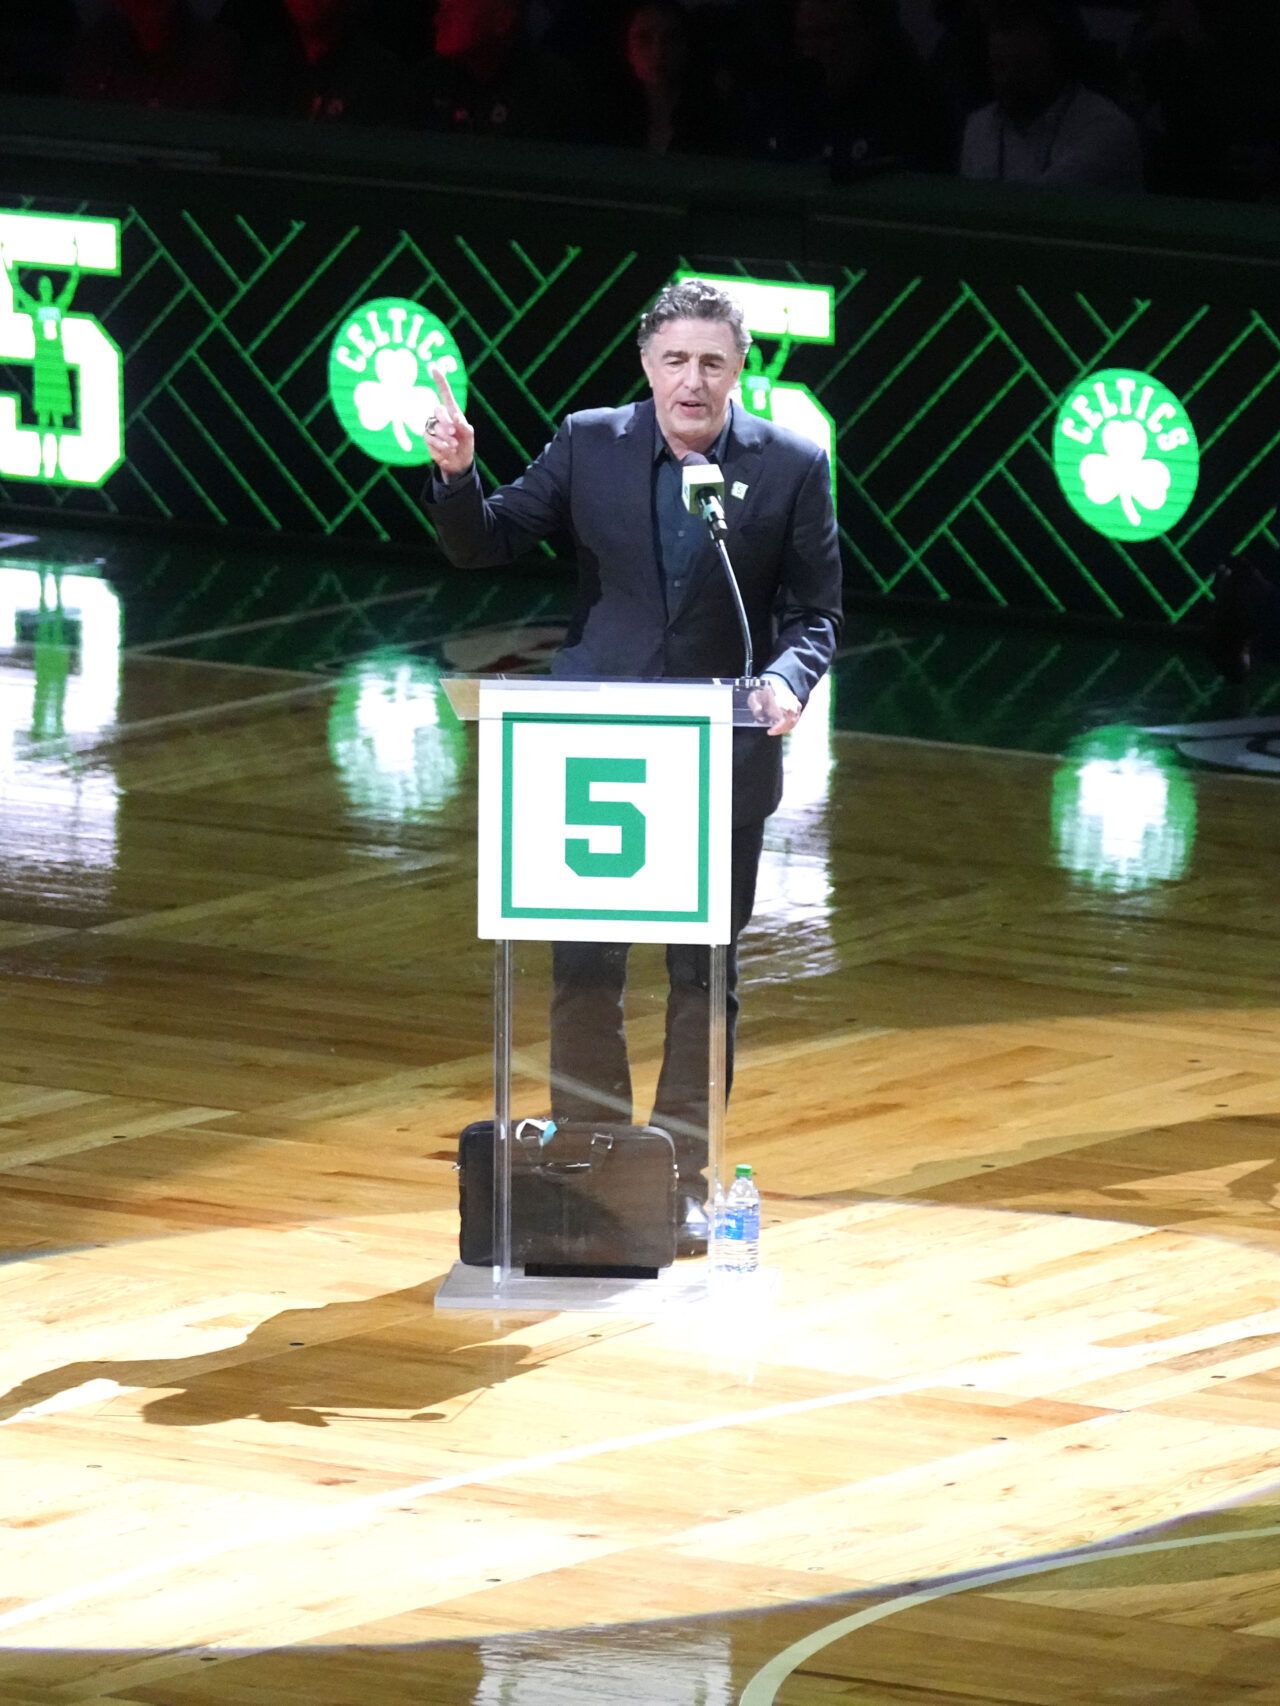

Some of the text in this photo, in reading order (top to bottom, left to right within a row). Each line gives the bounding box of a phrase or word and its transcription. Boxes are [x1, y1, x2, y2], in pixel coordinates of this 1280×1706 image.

[0, 208, 124, 488] 5
[336, 307, 458, 379] CELTICS
[1061, 378, 1190, 451] CELTICS
[565, 757, 647, 878] 5
